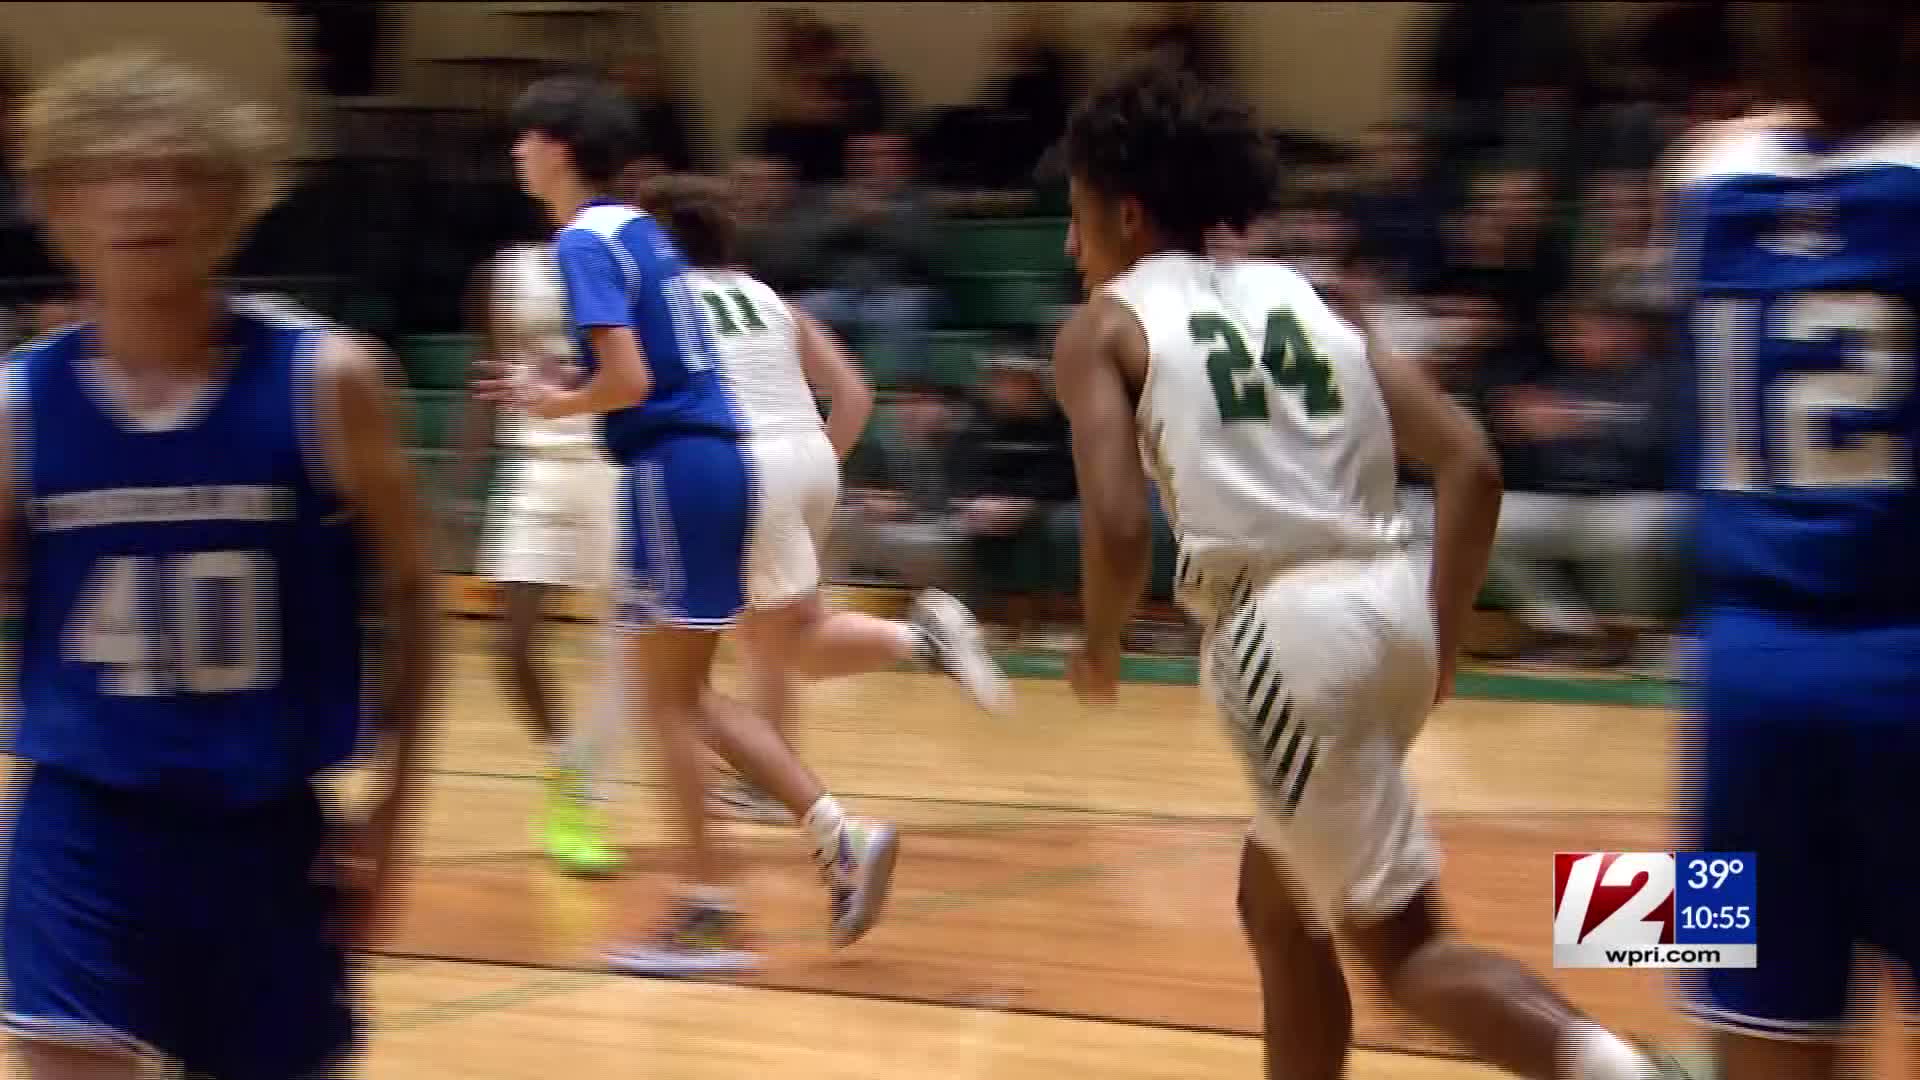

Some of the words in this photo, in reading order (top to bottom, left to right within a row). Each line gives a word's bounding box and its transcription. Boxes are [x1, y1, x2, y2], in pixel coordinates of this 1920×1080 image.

[699, 288, 768, 336] 11
[1188, 306, 1342, 424] 24
[1691, 291, 1915, 489] 12
[60, 552, 282, 697] 40
